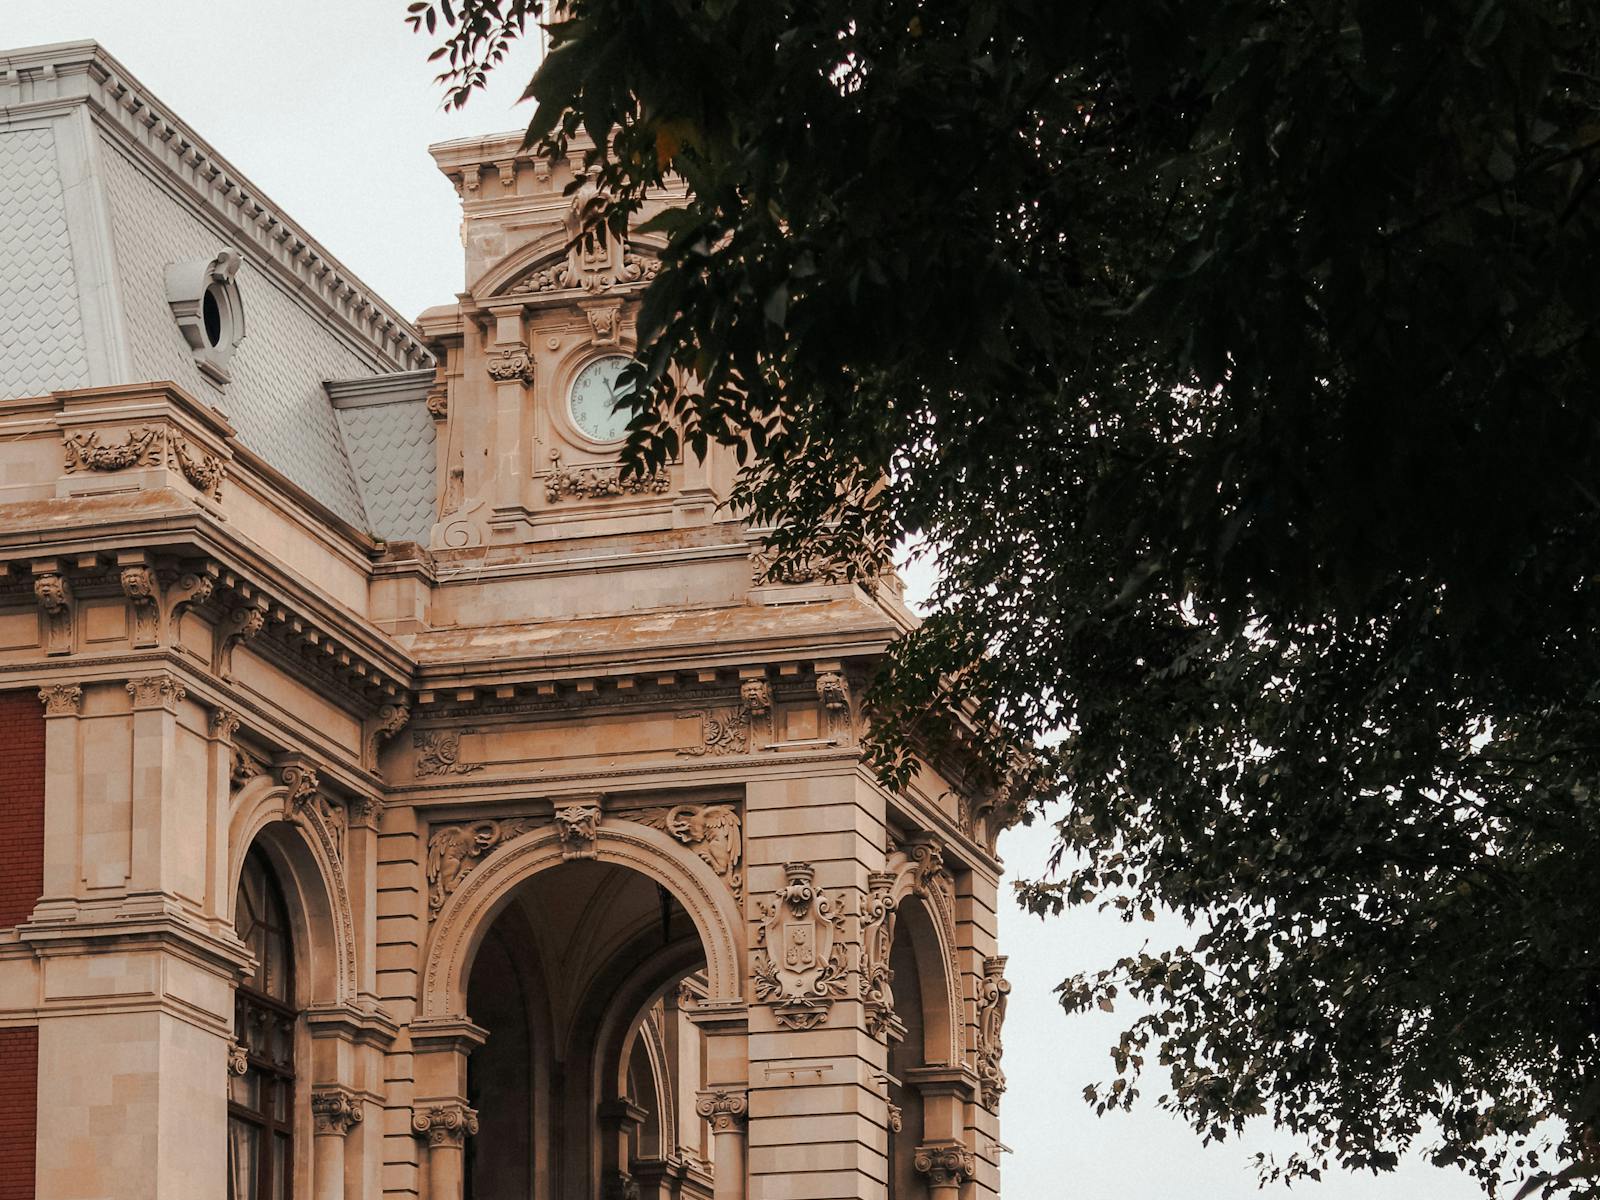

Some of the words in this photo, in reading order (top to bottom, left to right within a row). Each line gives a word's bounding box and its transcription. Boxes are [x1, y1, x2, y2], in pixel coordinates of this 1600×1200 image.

[611, 360, 620, 369] 12
[594, 367, 601, 376] 11
[583, 379, 591, 388] 10
[577, 395, 583, 404] 9
[581, 412, 586, 421] 8
[593, 424, 599, 434] 7
[609, 428, 615, 438] 6
